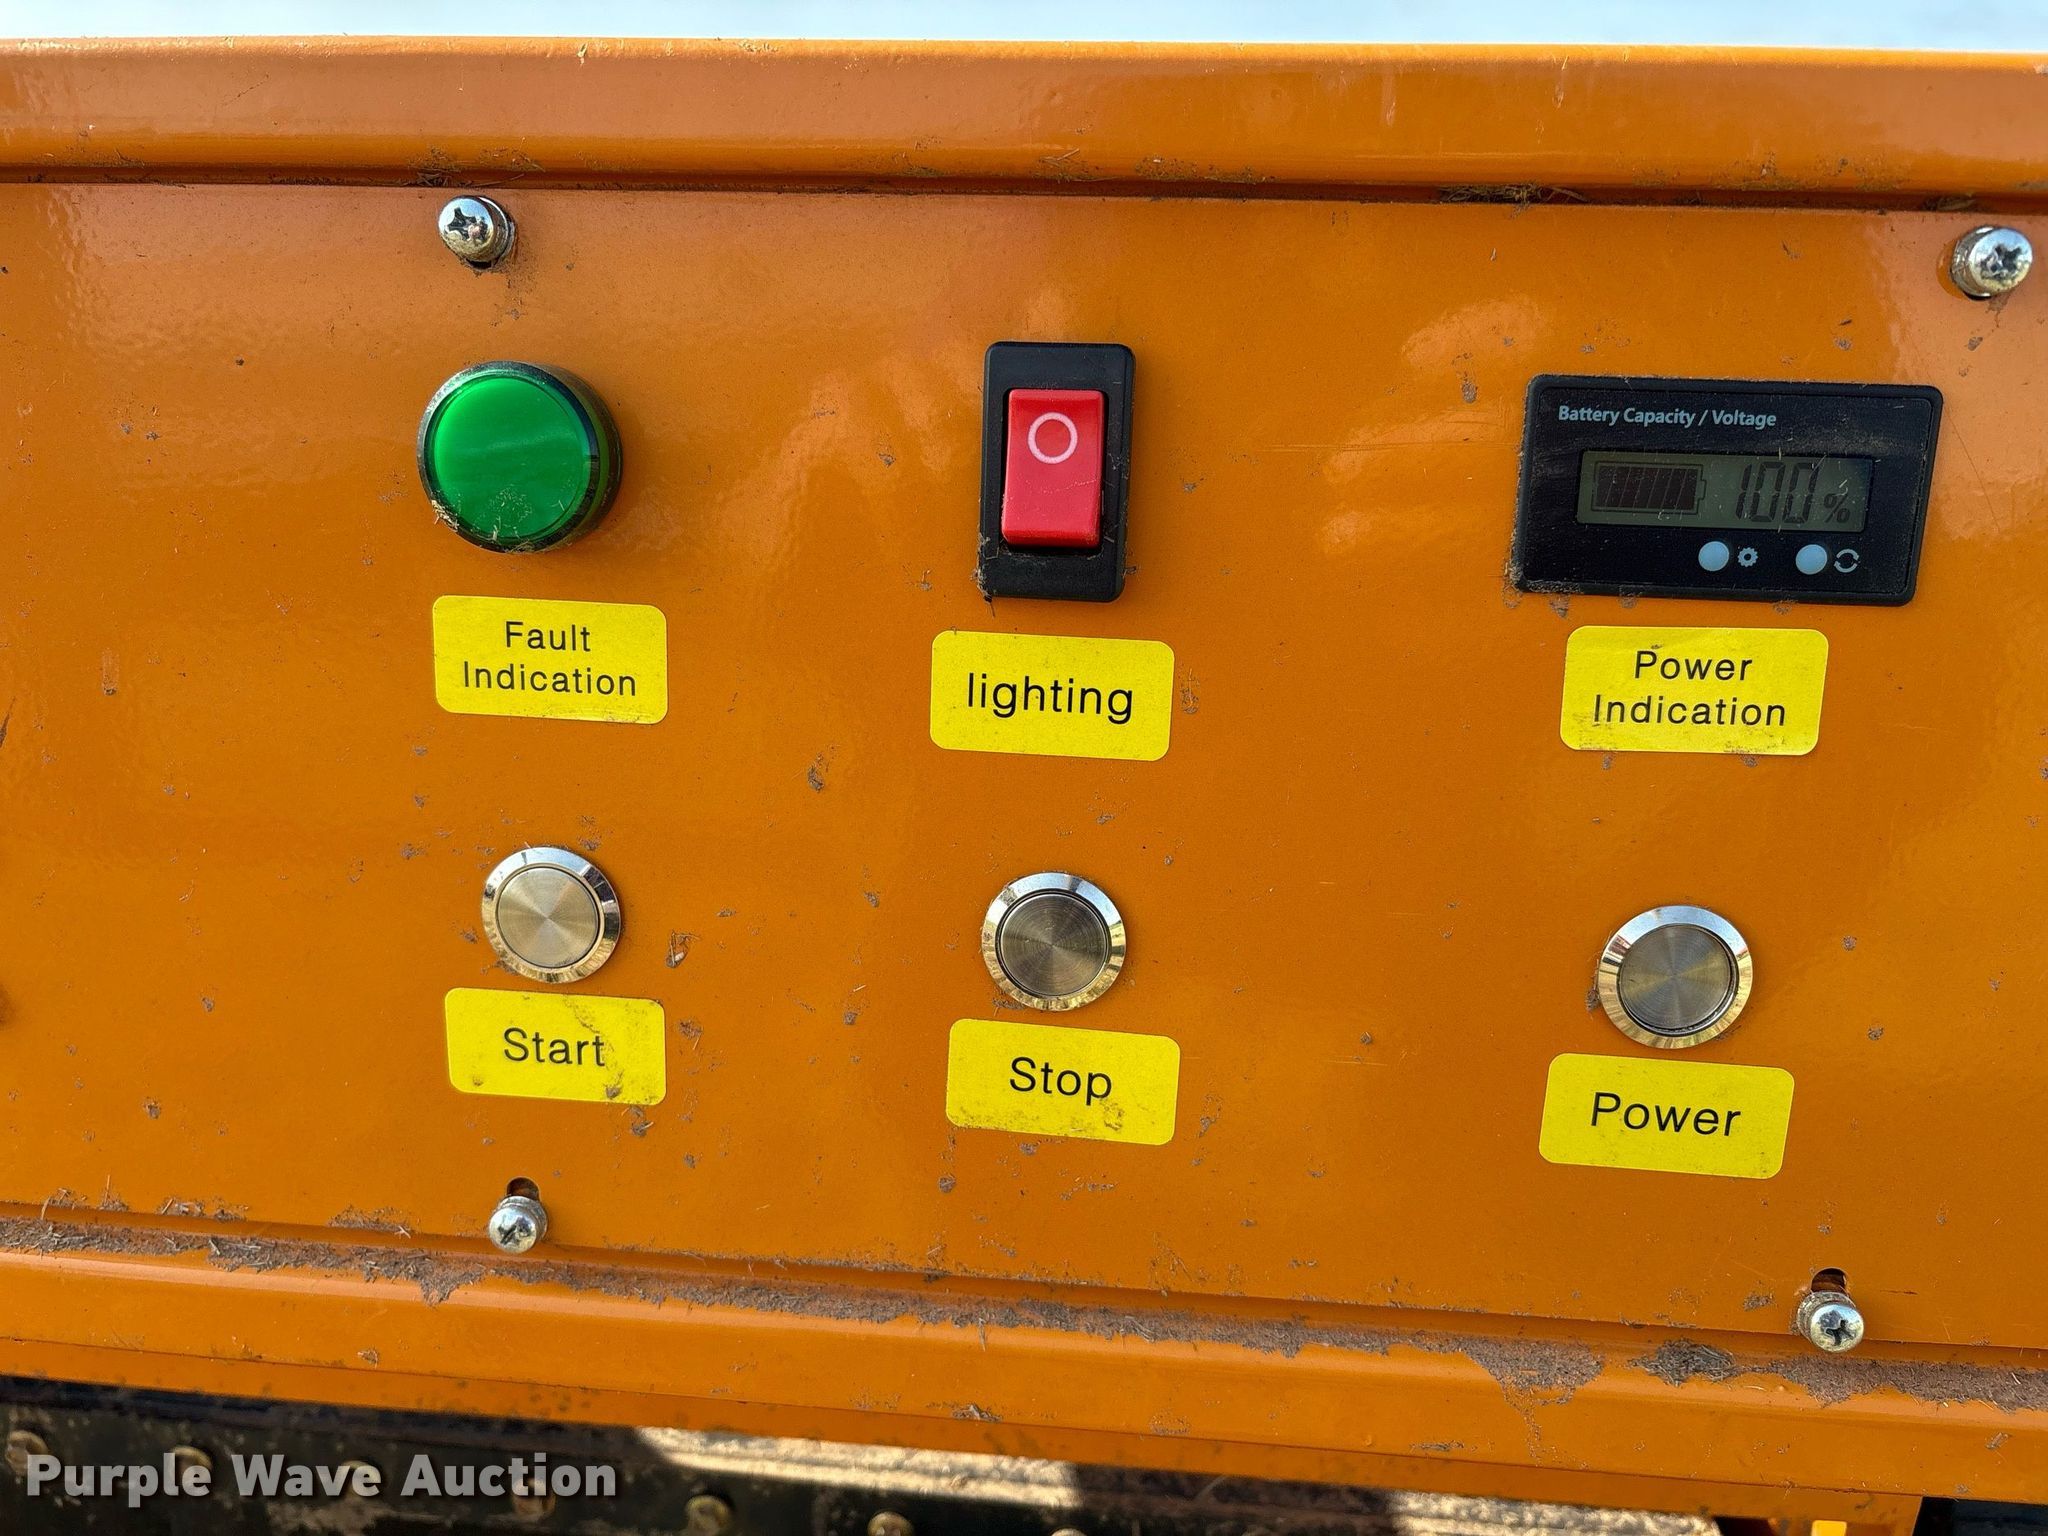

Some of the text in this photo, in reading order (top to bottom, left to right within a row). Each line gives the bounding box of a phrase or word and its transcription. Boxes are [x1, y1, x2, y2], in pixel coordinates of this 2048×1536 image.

[1558, 405, 1777, 430] Battery Capacity / Voltage
[505, 621, 592, 652] Fault
[464, 661, 637, 697] Indication
[1635, 650, 1754, 681] Power
[967, 671, 1134, 725] lighting
[1593, 693, 1786, 727] Indication
[503, 1027, 606, 1067] Start
[1009, 1056, 1113, 1106] Stop
[1590, 1092, 1742, 1138] Power
